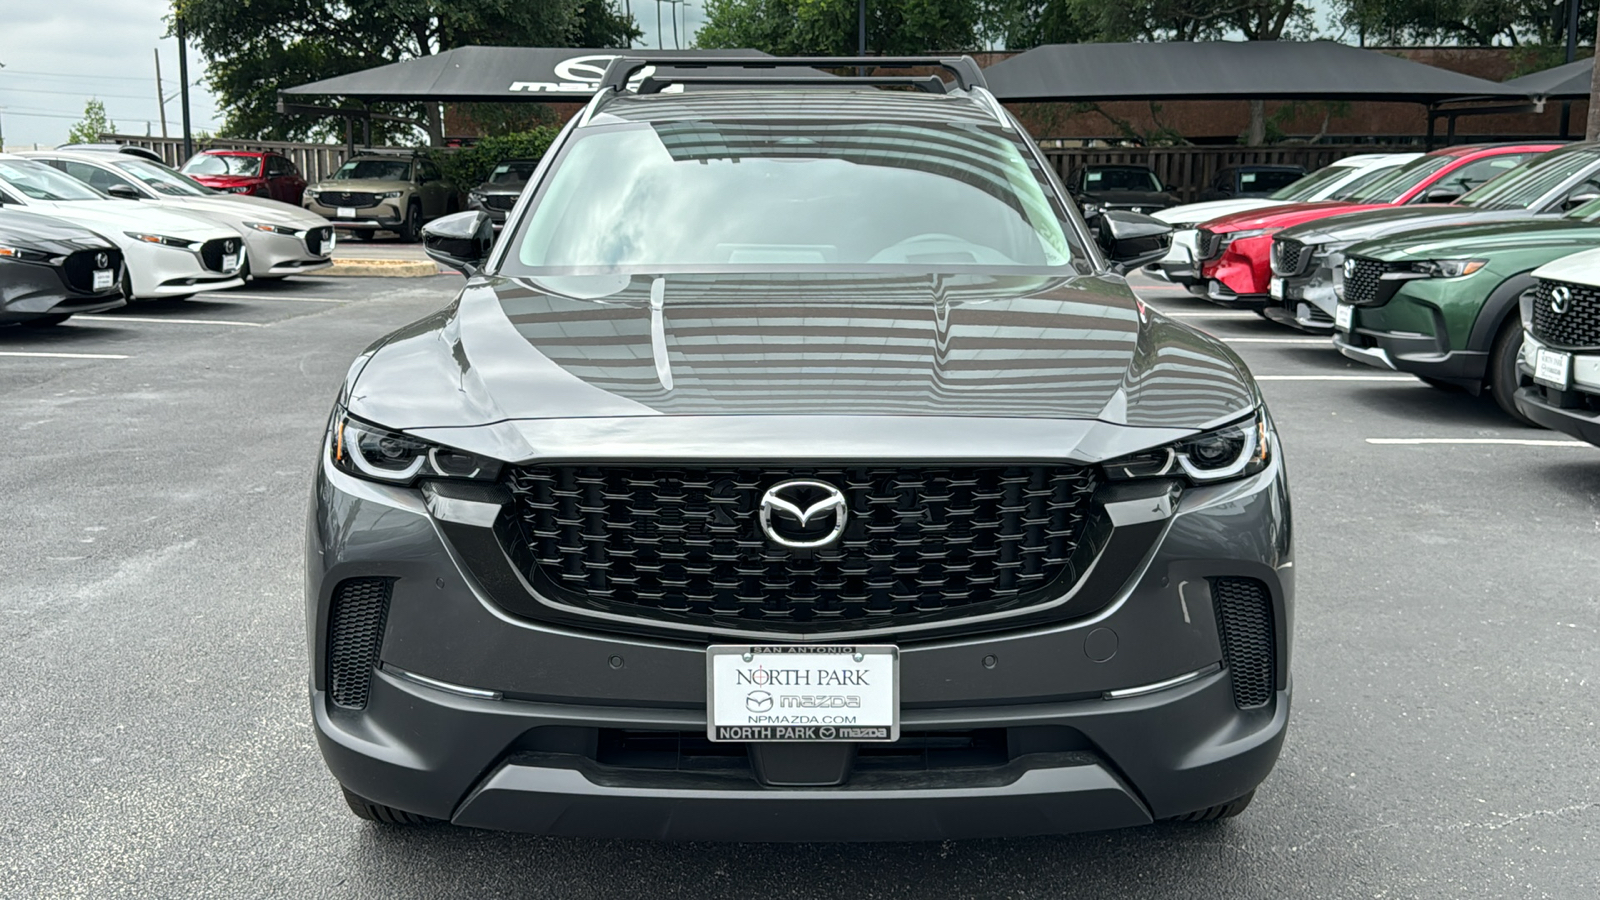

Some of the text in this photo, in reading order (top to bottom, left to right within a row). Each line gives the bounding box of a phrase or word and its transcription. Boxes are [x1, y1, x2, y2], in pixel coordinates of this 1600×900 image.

[509, 82, 684, 94] maa
[753, 646, 853, 654] SAN ANTONIO
[736, 669, 870, 686] NORTH PARK
[780, 695, 861, 708] mazda
[748, 715, 857, 724] NPMAZDA.COM
[719, 727, 887, 739] NORTH PARK mazda
